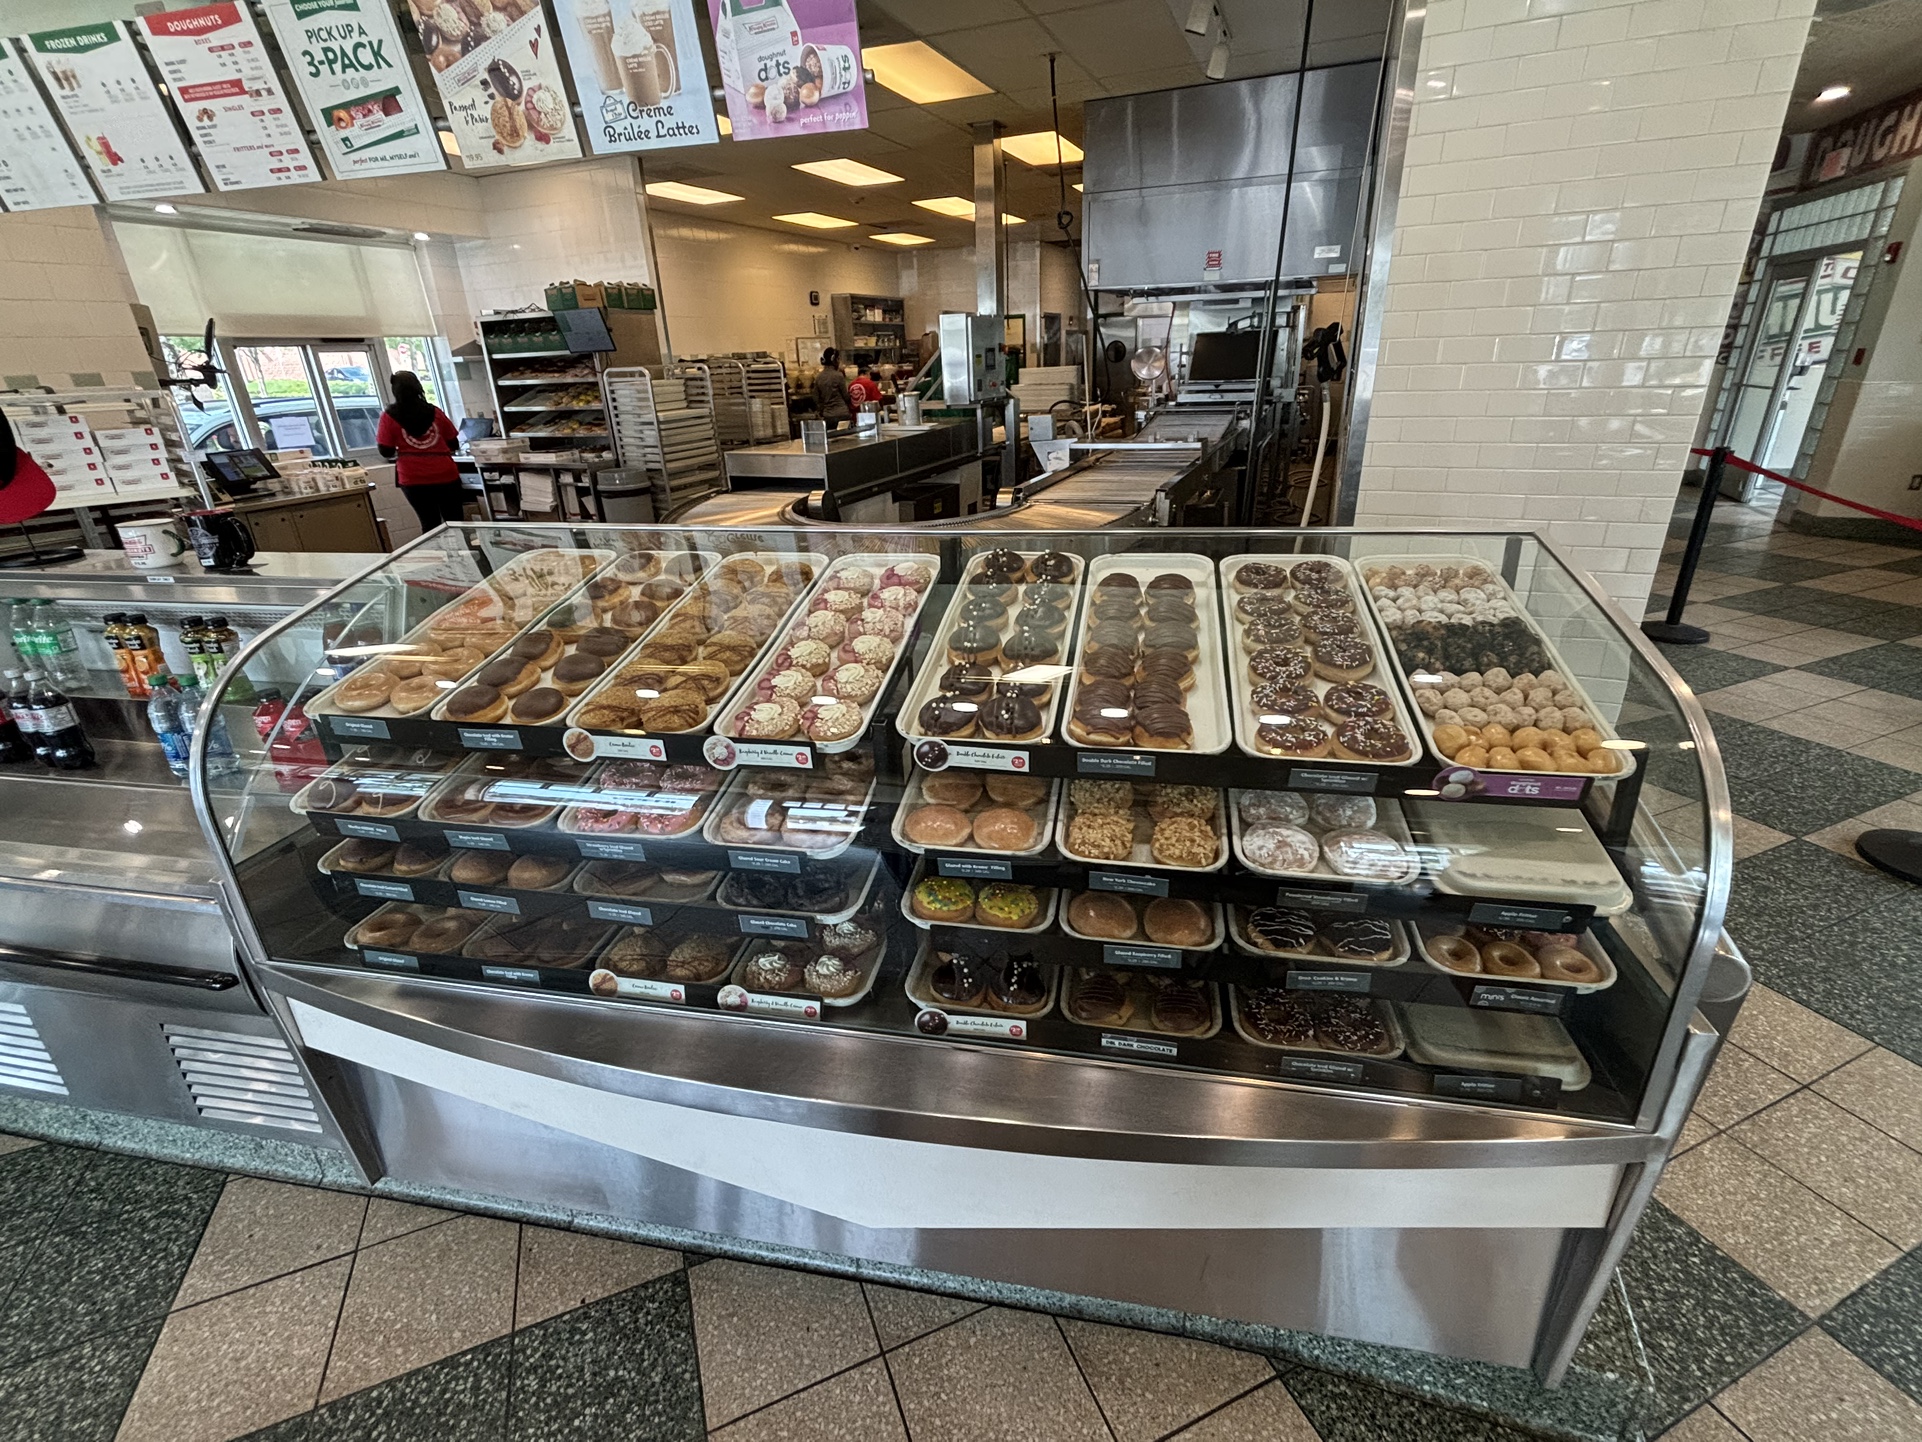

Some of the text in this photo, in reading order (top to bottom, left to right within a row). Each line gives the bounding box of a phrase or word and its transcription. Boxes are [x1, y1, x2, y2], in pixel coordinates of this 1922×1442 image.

[167, 14, 222, 32] DOUGHNUTS
[44, 32, 108, 51] FROZEN DRINKS
[304, 22, 368, 45] PICK UP A
[301, 39, 394, 78] 3-PACK
[757, 49, 787, 62] doughnut
[758, 60, 791, 82] dots
[449, 98, 477, 118] Passport
[627, 101, 674, 120] Crème
[800, 114, 823, 127] perfect
[824, 112, 834, 121] for
[604, 120, 700, 143] Brûlée Lattes
[1127, 879, 1157, 887] Cheesecake
[1136, 1044, 1173, 1054] CHOCOLATE
[1292, 1061, 1317, 1069] Chocolate
